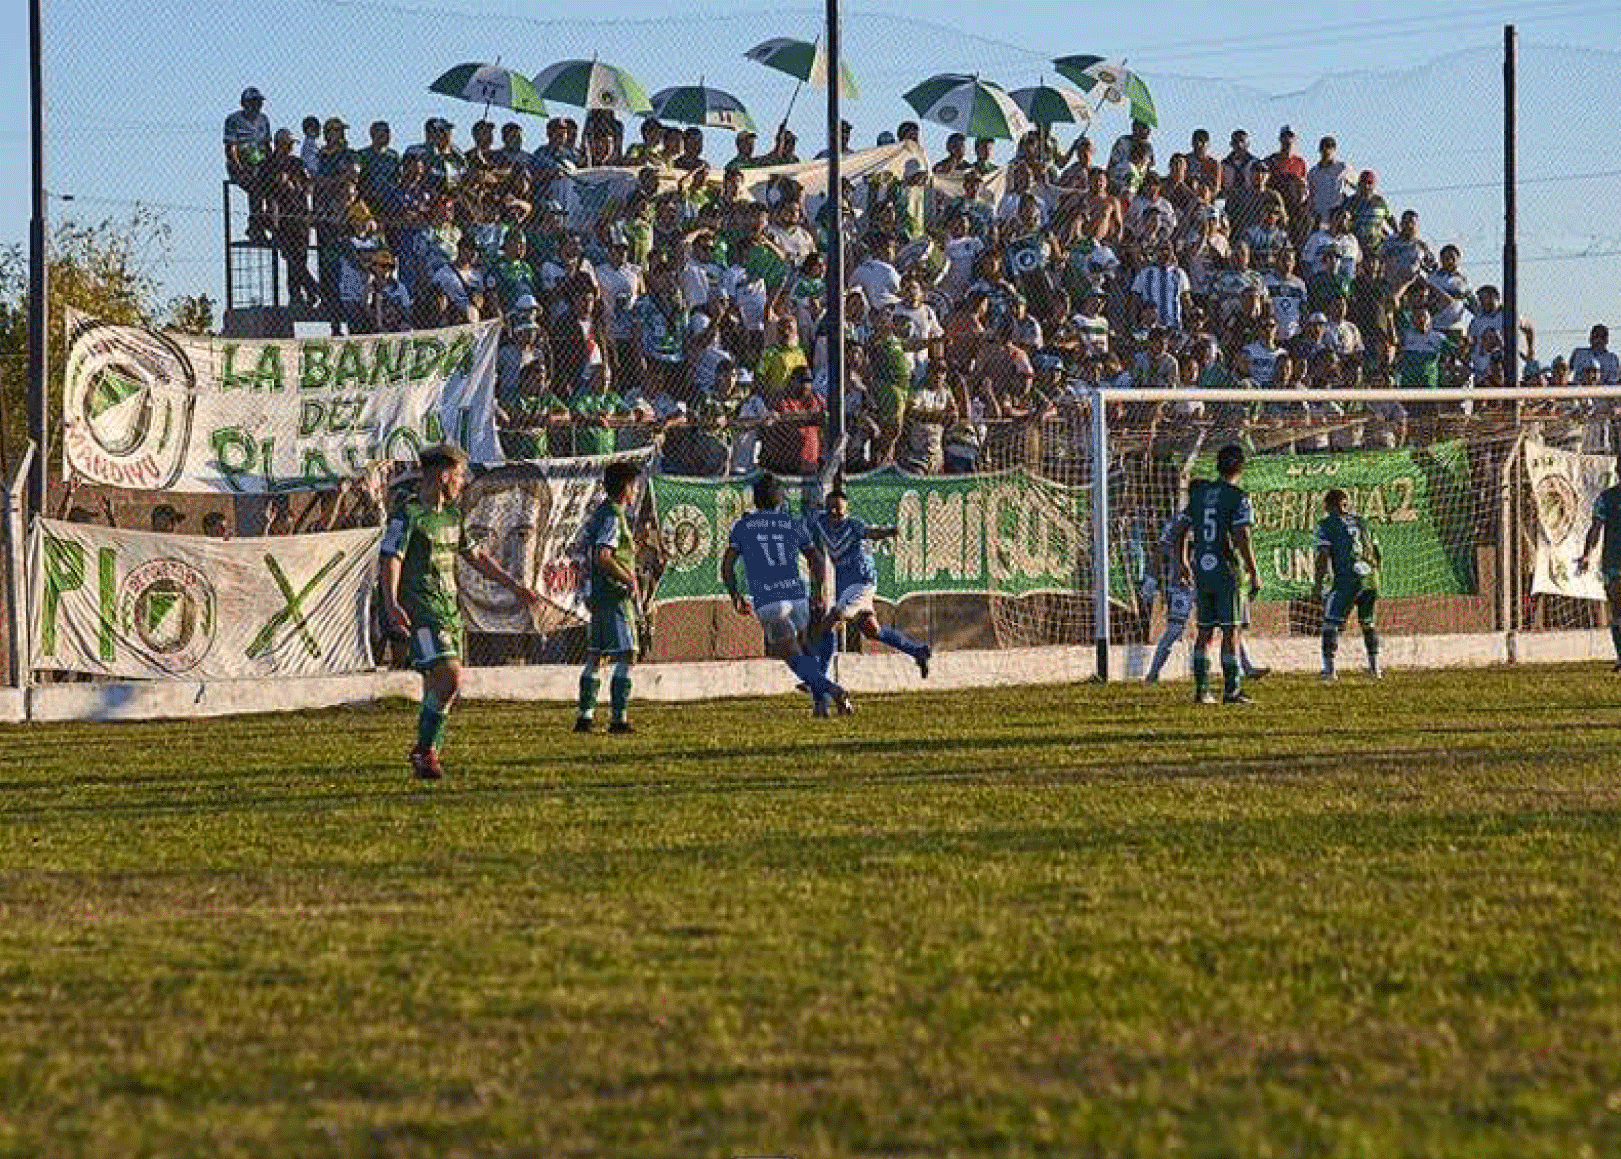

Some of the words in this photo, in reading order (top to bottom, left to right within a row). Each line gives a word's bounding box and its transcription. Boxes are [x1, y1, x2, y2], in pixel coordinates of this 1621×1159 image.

[218, 344, 282, 390] LA
[894, 487, 1080, 584] AMIGOS
[1203, 507, 1218, 542] 5
[756, 532, 788, 567] 11
[246, 551, 346, 661] X
